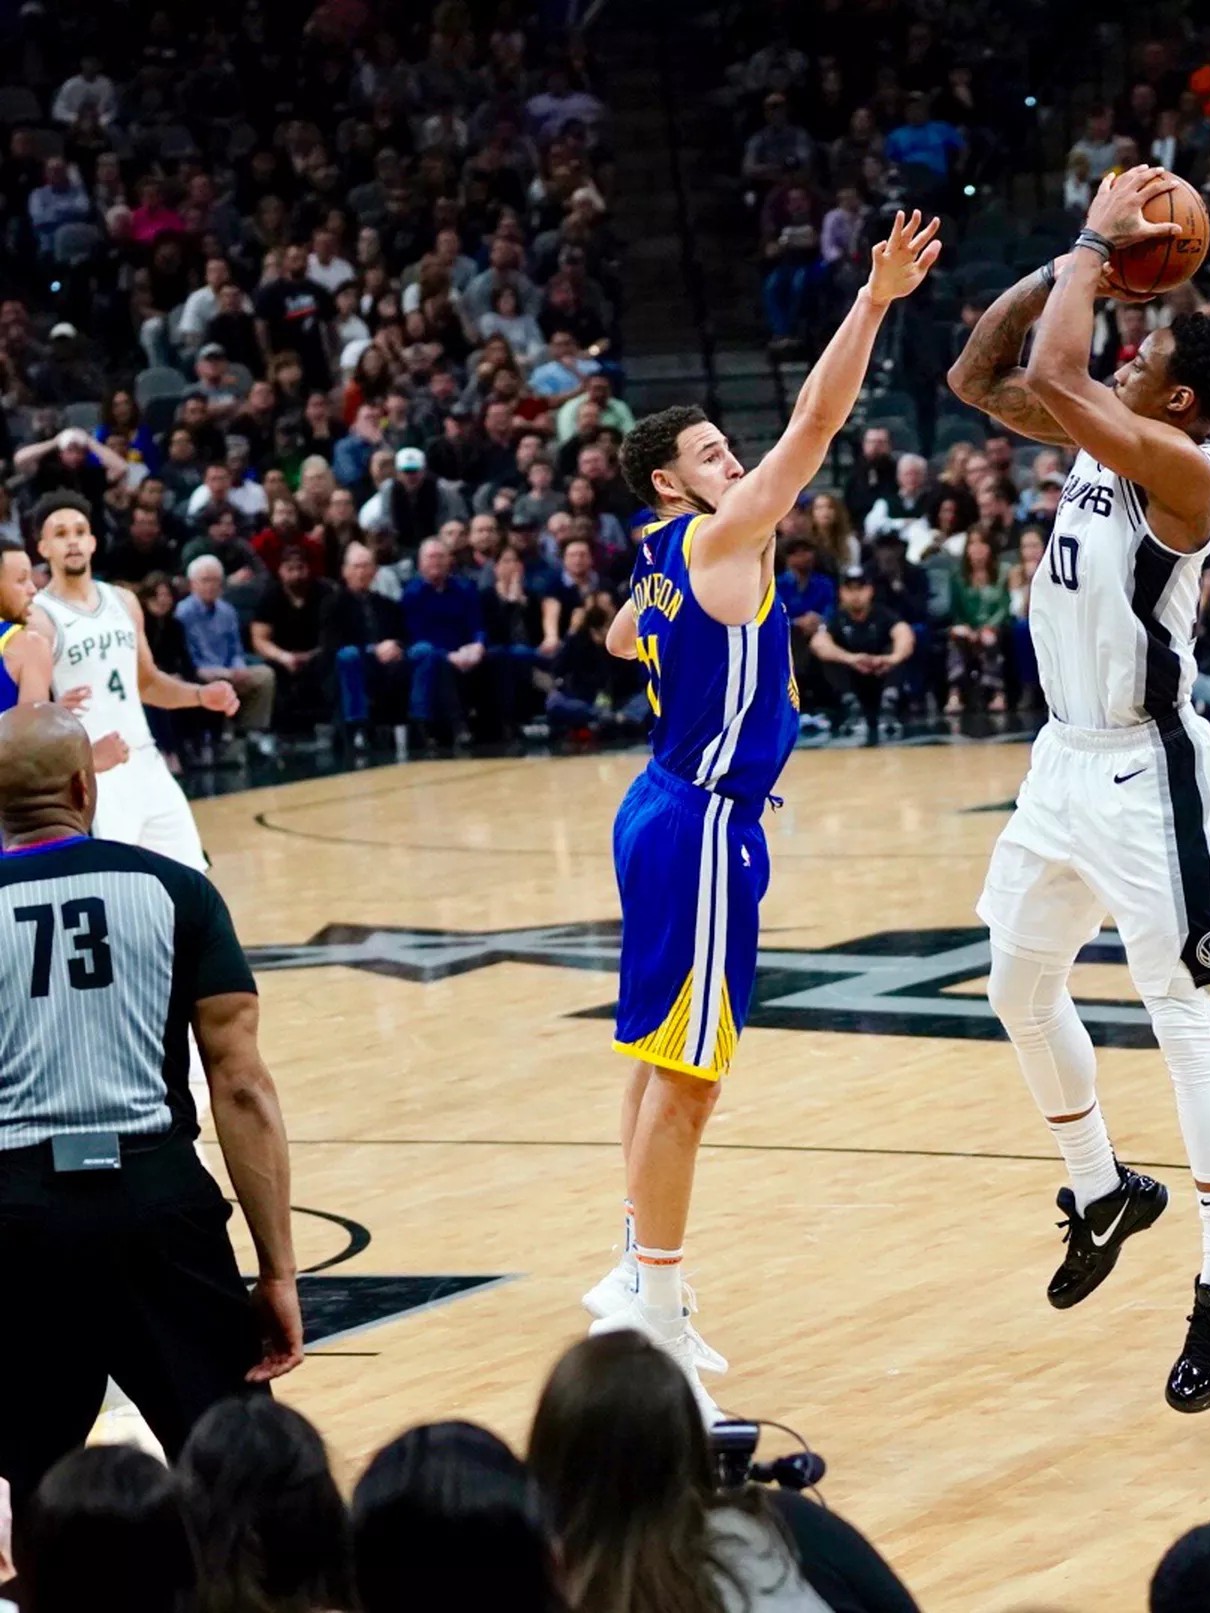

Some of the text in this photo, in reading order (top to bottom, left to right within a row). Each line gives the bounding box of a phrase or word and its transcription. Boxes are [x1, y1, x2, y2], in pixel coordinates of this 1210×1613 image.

[1049, 533, 1080, 591] 10
[108, 668, 126, 700] 4
[13, 896, 114, 998] 73
